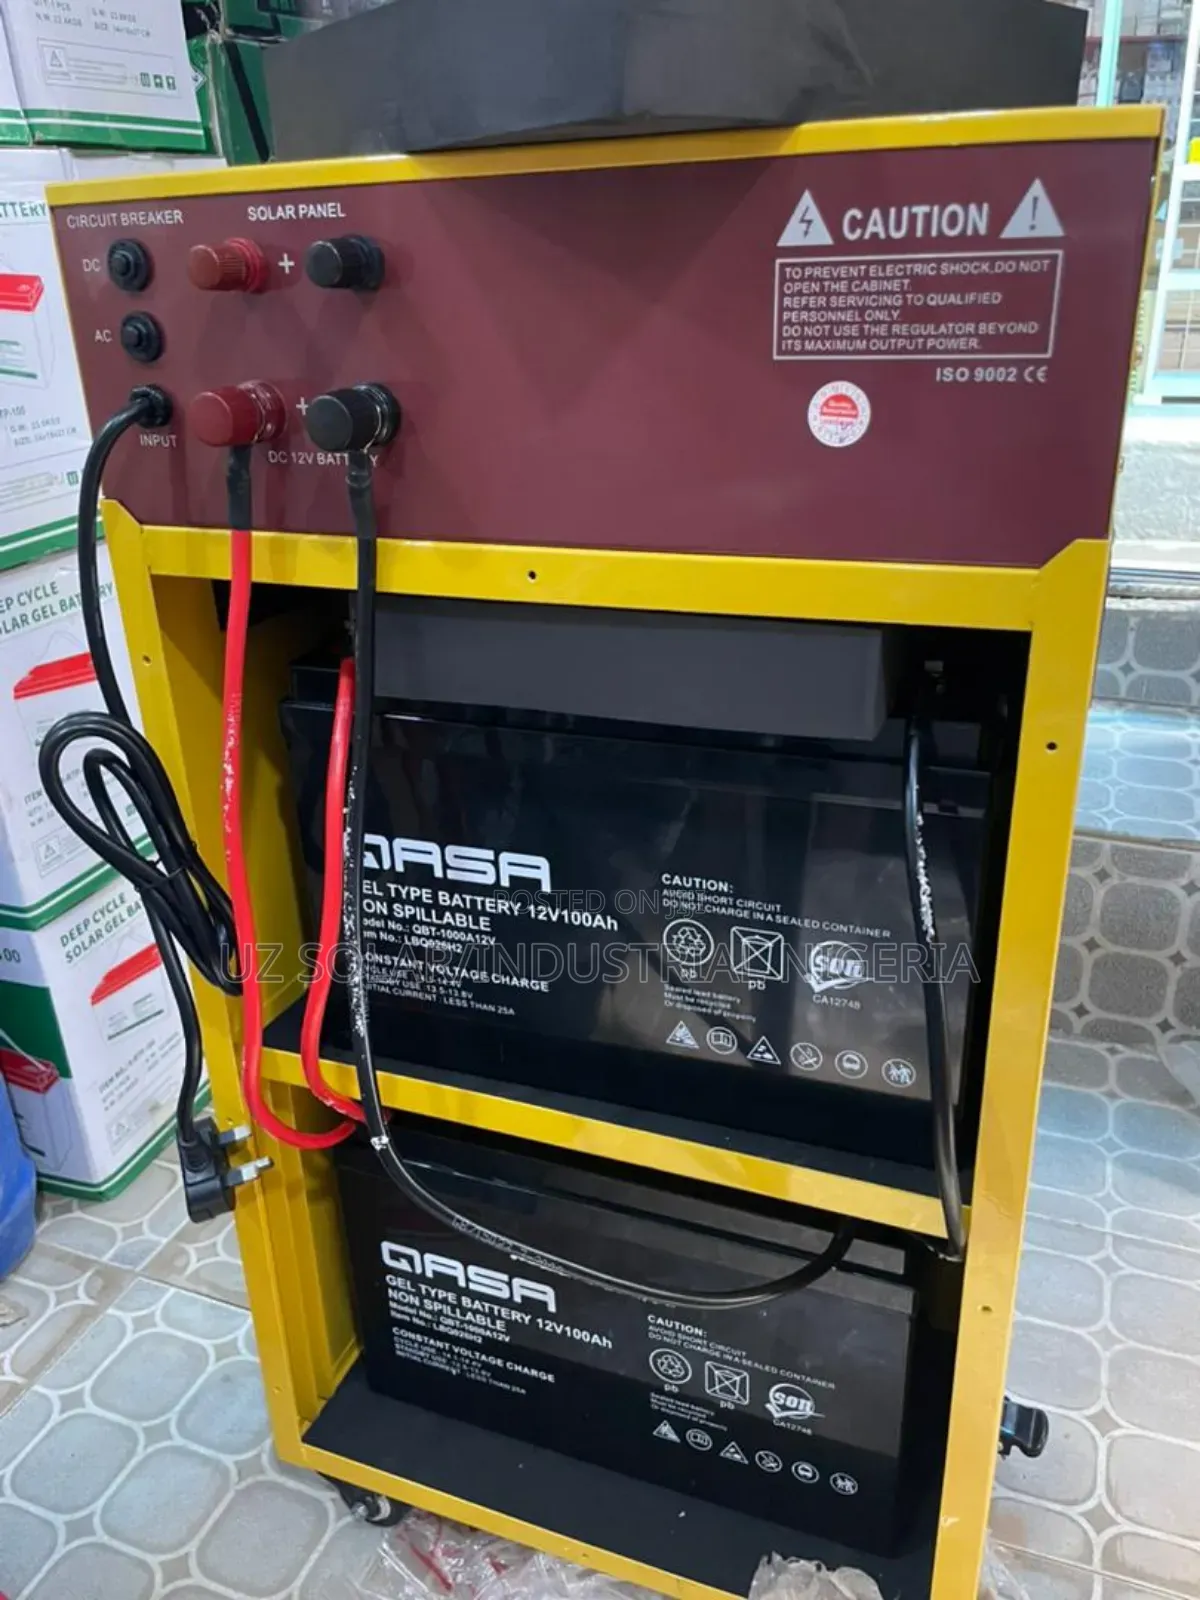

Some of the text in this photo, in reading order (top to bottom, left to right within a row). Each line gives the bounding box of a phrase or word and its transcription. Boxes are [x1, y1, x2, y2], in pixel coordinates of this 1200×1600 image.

[0, 202, 46, 217] TTERY
[67, 210, 183, 229] CIRCUIT BREAKER
[247, 203, 346, 221] SOLAR PANEL
[842, 202, 989, 241] CAUTION
[83, 259, 100, 272] DC
[785, 267, 801, 279] TO
[804, 265, 866, 279] PREVENT
[870, 263, 937, 278] ELECTRIC
[1018, 260, 1050, 272] NOT
[784, 281, 818, 294] OPEN
[821, 280, 848, 293] THE
[783, 292, 1002, 309] REFER SERVICING TO QUALIFIED
[783, 310, 861, 322] PERSONNEL
[95, 330, 112, 342] AC
[782, 321, 1039, 338] DO NOT USE THE REGULATOR BEYOND
[782, 339, 801, 351] ITS
[804, 338, 867, 351] MAXIMUM
[869, 338, 924, 350] OUTPUT
[935, 367, 969, 382] ISO
[973, 367, 1017, 382] 9002
[140, 434, 176, 447] INPUT
[268, 451, 378, 467] DC 12V BATTY
[17, 582, 59, 606] CYCLE
[31, 604, 58, 622] GEL
[59, 582, 112, 612] BATRY
[661, 873, 734, 893] CAUTION:
[363, 880, 618, 932] EL TYPE BATTERY 12V100Ah
[697, 894, 734, 906] SHORT
[736, 899, 781, 912] CIRCUIT
[60, 918, 90, 947] DEEP
[92, 893, 126, 923] CYCLE
[363, 899, 492, 932] ON SPILLABLE
[663, 899, 678, 908] DO
[704, 904, 751, 918] CHARGE
[753, 912, 764, 920] IN
[765, 914, 773, 922] A
[776, 915, 820, 929] SEALED
[822, 921, 891, 938] CONTAINER
[65, 912, 126, 963] SOLAR GEL
[363, 918, 385, 928] odel
[412, 924, 496, 945] QBT-1000A12V
[365, 952, 550, 992] ONSTANT VOLTAGE CHARGE
[392, 988, 437, 1002] CURRENT
[444, 998, 468, 1008] LESS
[470, 1001, 496, 1012] THAN
[381, 1241, 556, 1313] QASA
[385, 1274, 613, 1349] GEL TYPE BATTERY 12V100Ah
[388, 1288, 506, 1331] NON SPILLABLE
[647, 1314, 707, 1338] CAUTION:
[392, 1327, 555, 1383] CONSTANT VOLTAGE CHARGE
[677, 1333, 708, 1346] SHORT
[709, 1340, 747, 1358] CIRCUIT
[648, 1332, 662, 1341] DO
[664, 1336, 682, 1346] NOT
[684, 1340, 721, 1359] CHARGE
[733, 1356, 740, 1364] A
[741, 1359, 778, 1375] SEALED
[779, 1369, 836, 1390] CONTAINER
